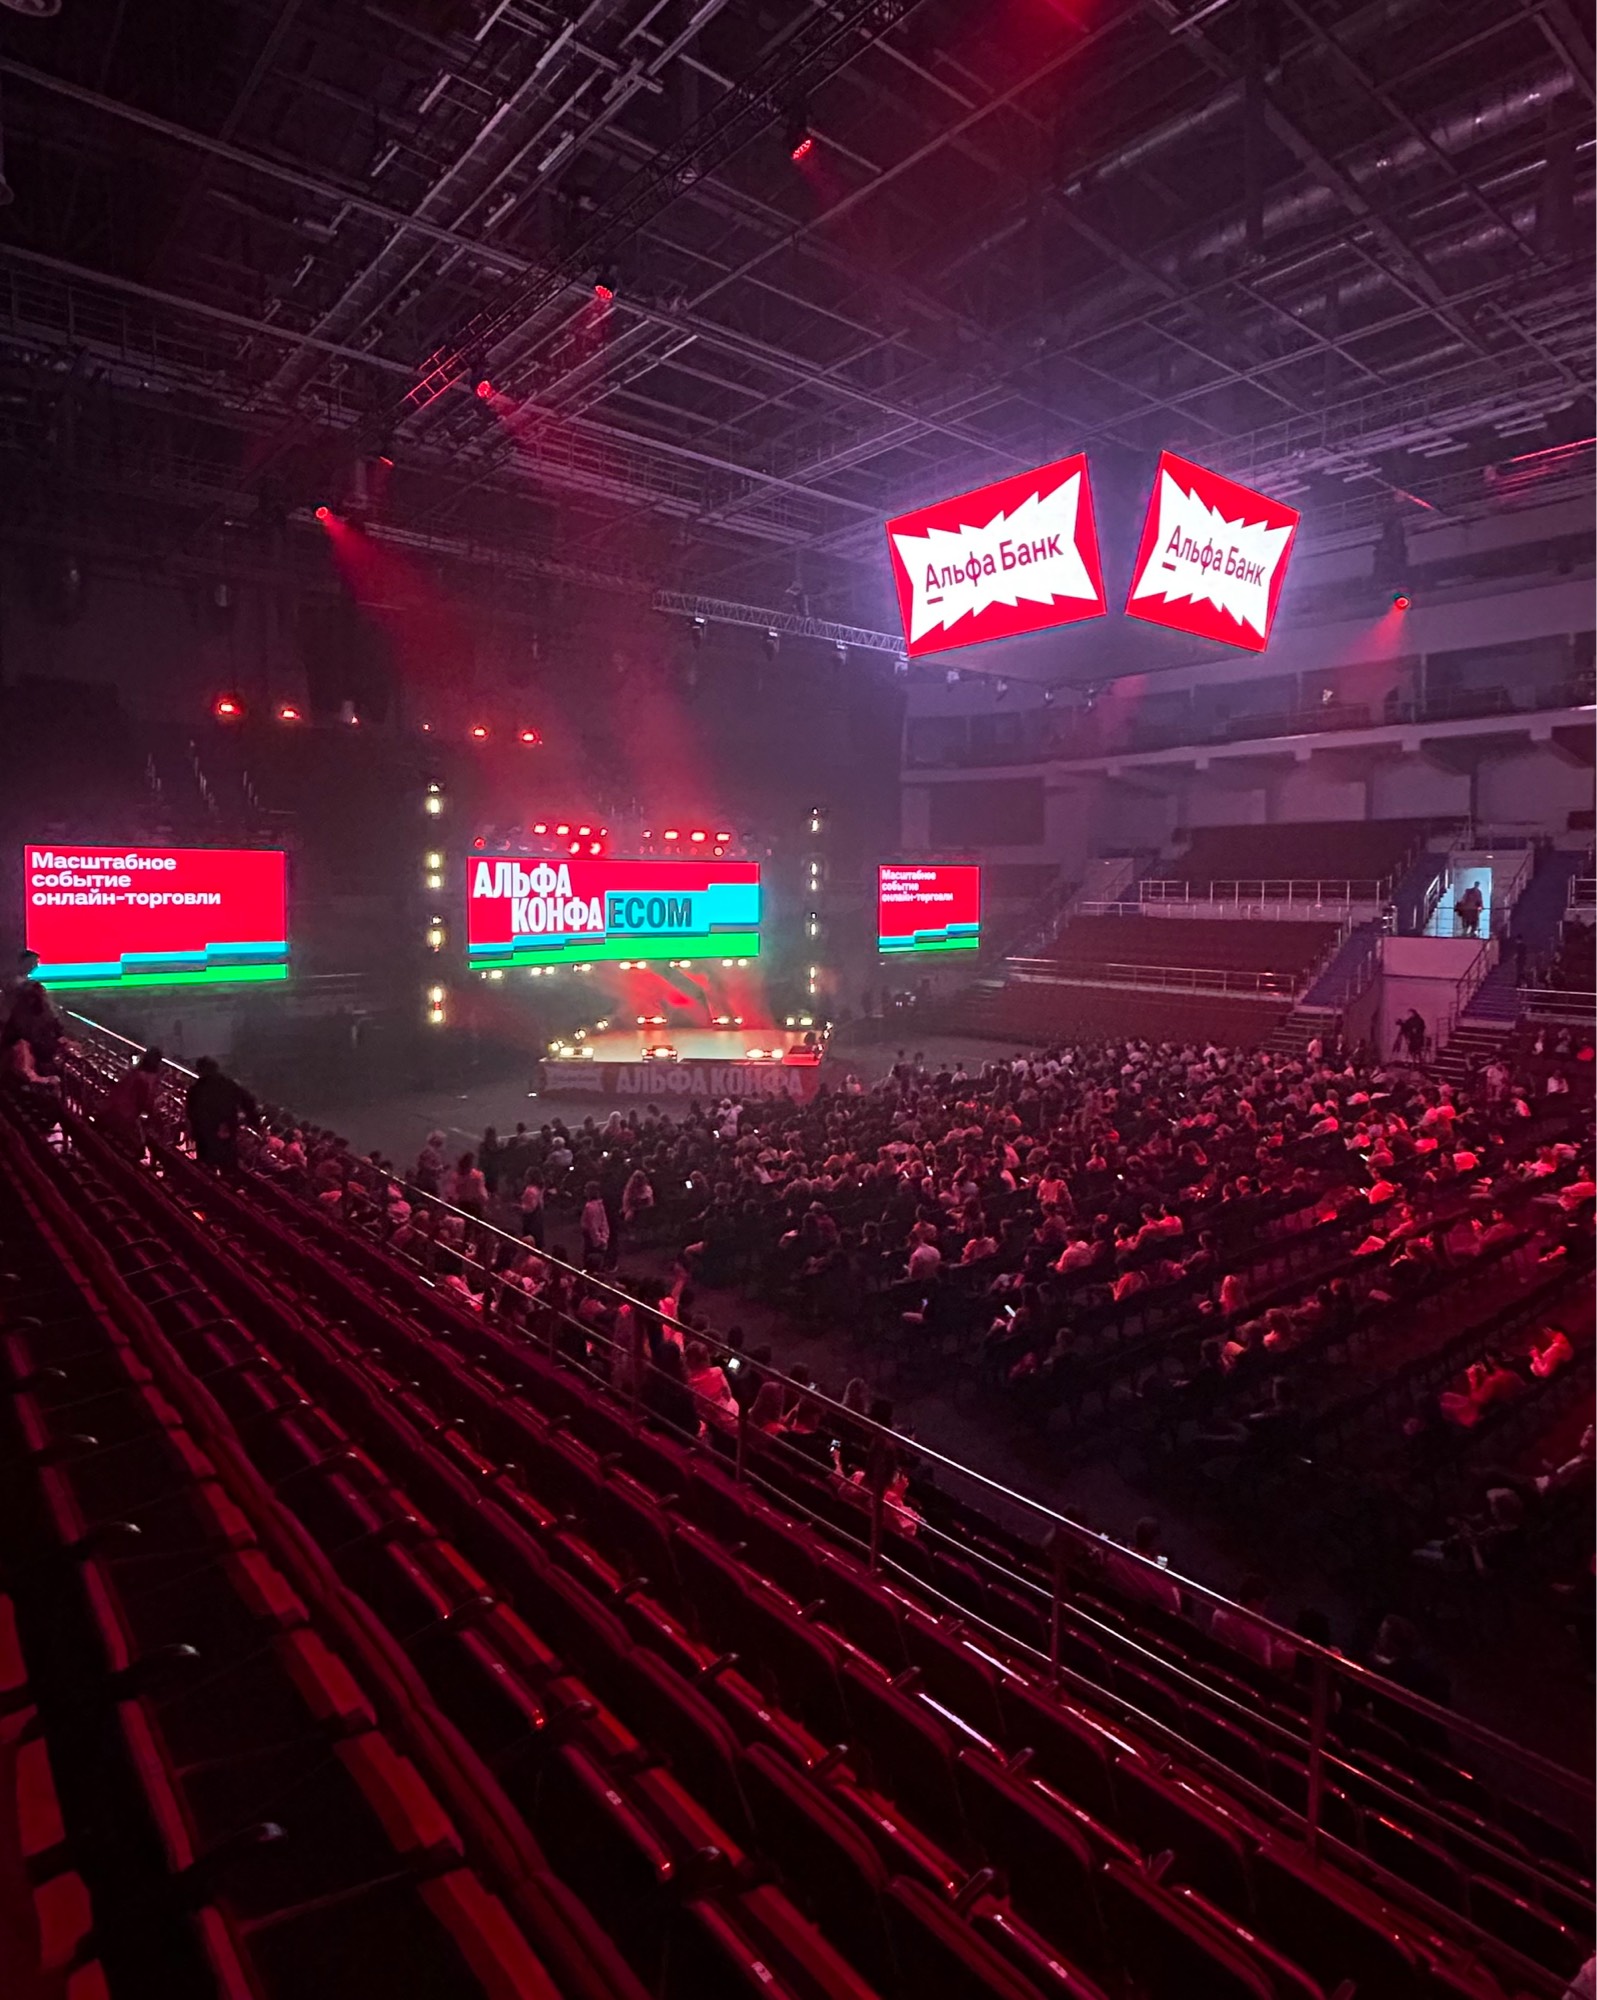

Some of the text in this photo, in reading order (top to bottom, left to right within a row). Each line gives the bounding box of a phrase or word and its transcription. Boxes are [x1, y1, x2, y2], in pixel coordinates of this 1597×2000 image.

[926, 533, 1064, 593] Альфа Банк
[1165, 525, 1266, 587] Альфа Банк
[31, 852, 177, 870] Масштабное
[881, 869, 937, 881] Масштабное
[31, 871, 132, 887] событие
[473, 862, 573, 898] АЛЬФА
[881, 880, 920, 892] событие
[31, 888, 222, 908] онлайн-торговли
[608, 897, 693, 929] ECOM
[511, 897, 604, 933] КОНФА
[615, 1065, 709, 1094] АЛЬФА
[711, 1065, 804, 1095] КОНФА
